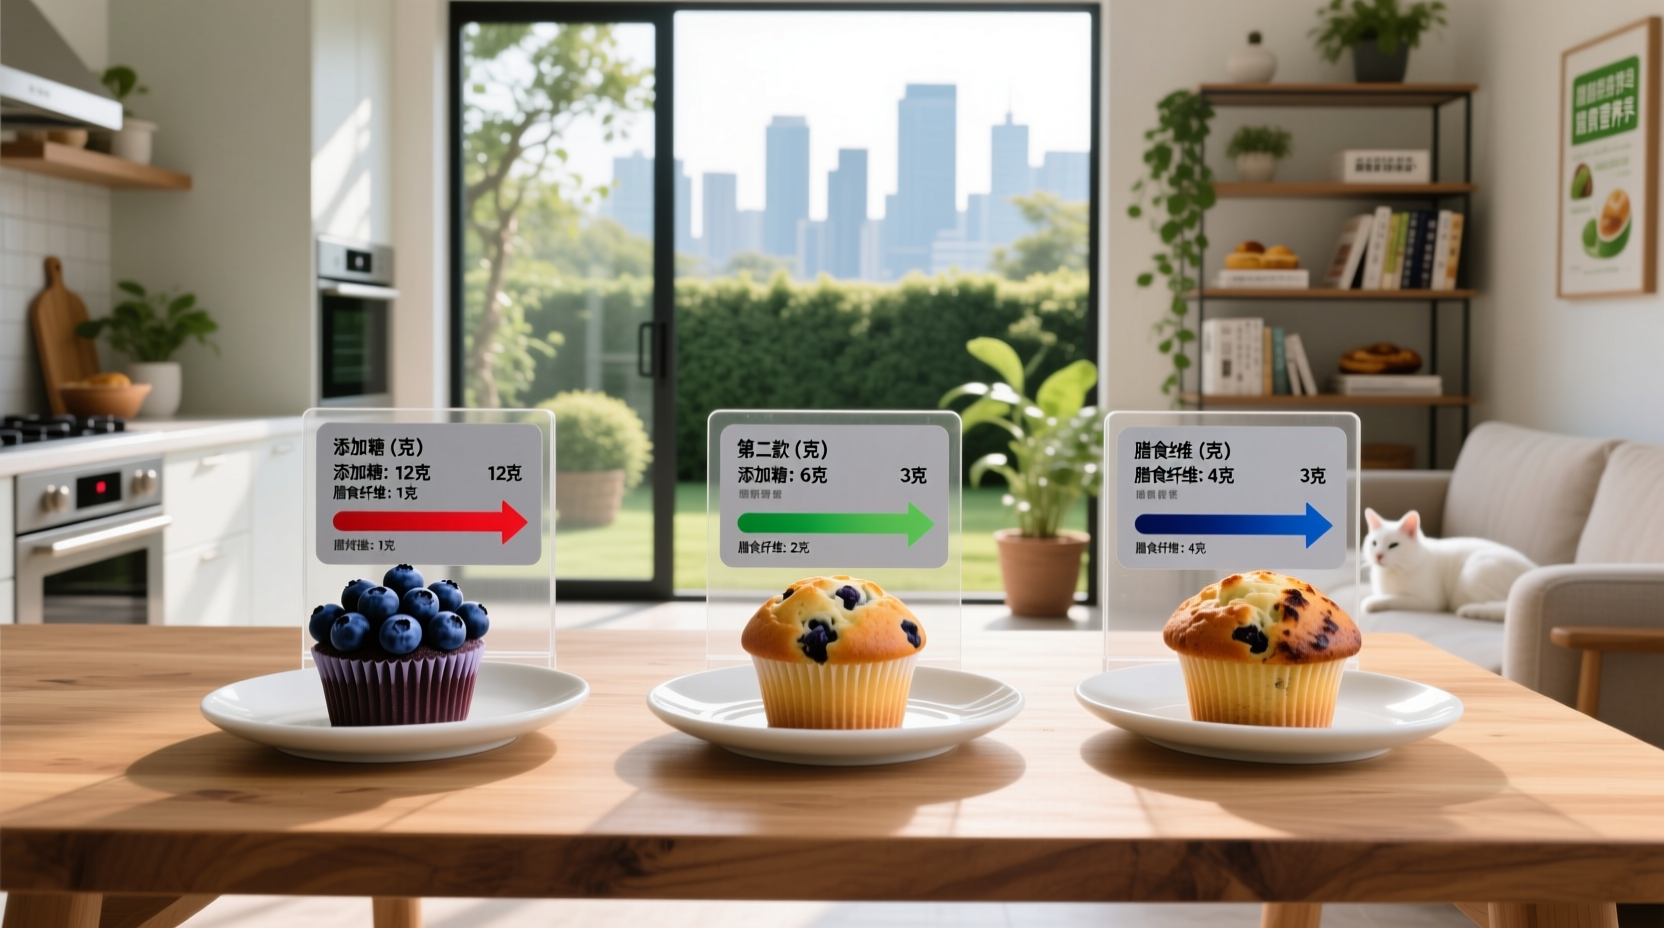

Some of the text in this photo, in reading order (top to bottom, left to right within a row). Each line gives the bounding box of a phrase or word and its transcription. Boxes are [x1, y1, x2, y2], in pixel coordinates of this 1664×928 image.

[332, 436, 424, 458] 添加糖 (克)
[795, 439, 828, 461] (克)
[1199, 440, 1231, 461] (克)
[395, 463, 431, 482] 12克
[487, 463, 523, 482] 12克
[800, 465, 828, 484] 6克
[900, 465, 928, 485] 3克
[1207, 466, 1235, 485] 4克
[1300, 466, 1327, 485] 3克
[396, 483, 418, 501] 1克
